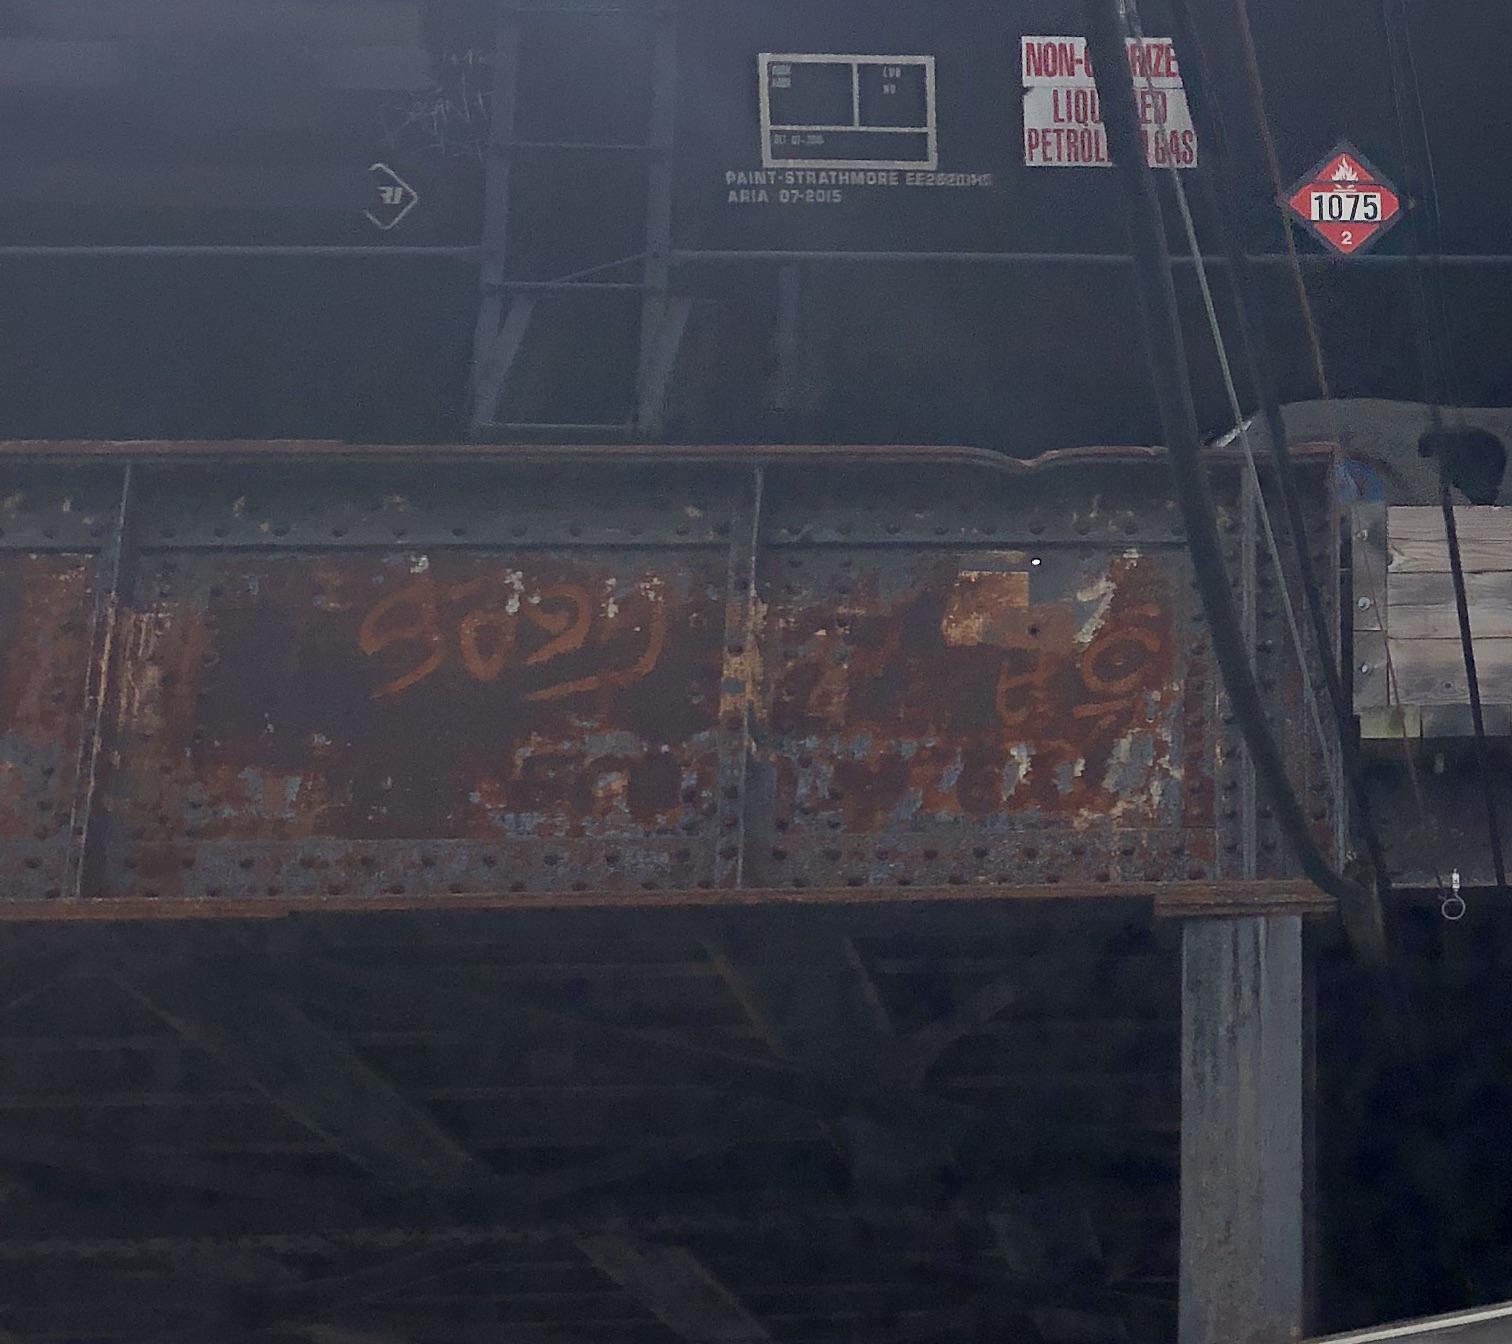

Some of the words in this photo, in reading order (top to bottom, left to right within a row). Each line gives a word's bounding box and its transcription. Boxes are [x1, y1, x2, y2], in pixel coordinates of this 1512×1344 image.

[728, 189, 769, 203] ARIA
[779, 189, 842, 203] 07-2015
[1314, 194, 1378, 221] 1075
[1341, 230, 1352, 245] 2
